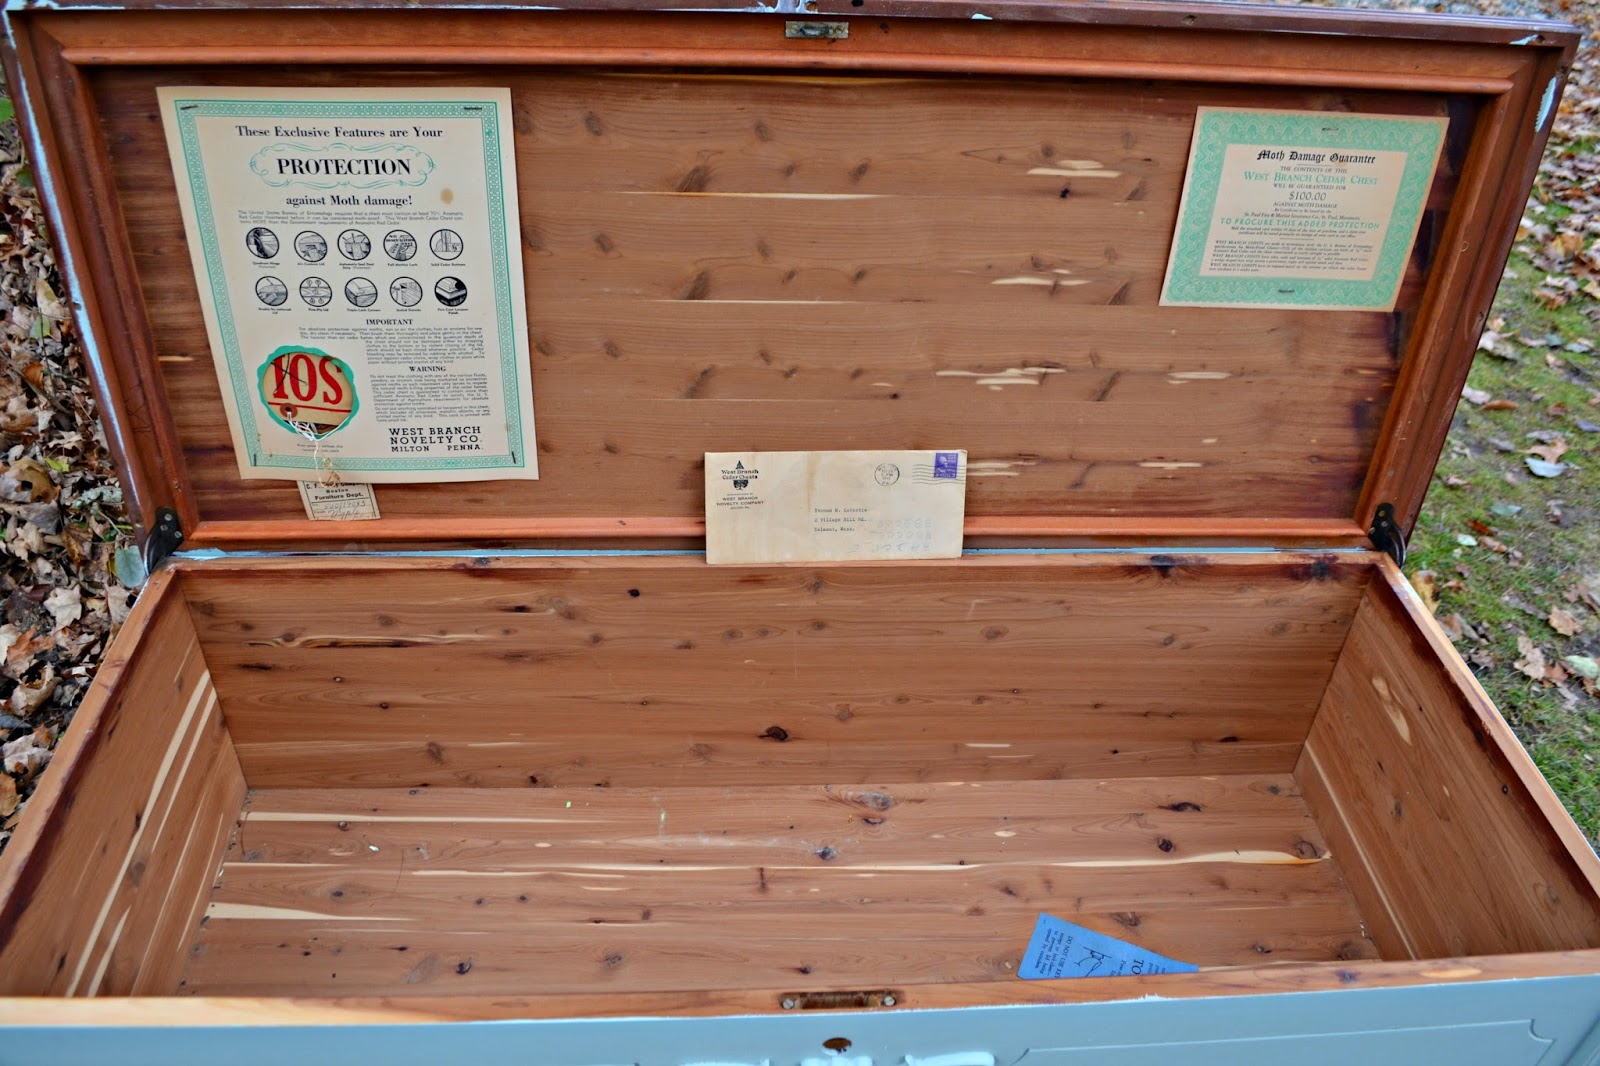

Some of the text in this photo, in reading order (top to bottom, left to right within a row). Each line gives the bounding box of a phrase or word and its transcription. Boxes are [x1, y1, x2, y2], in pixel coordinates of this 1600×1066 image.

[235, 126, 443, 138] These Exclusive Features are Your
[1257, 149, 1376, 164] Moth Damage Guarantee
[276, 158, 411, 175] PROTECTION
[286, 195, 412, 208] against Moth damage!
[1288, 190, 1327, 201] $100.00
[1220, 217, 1380, 229] TO PROCURE THIS ADDED PROTECTION
[389, 426, 481, 436] WEST BRANCH
[390, 435, 483, 445] NOVELTY CO.
[391, 445, 430, 453] MILTON
[1066, 935, 1074, 945] DO
[1062, 944, 1070, 957] NOT
[1058, 957, 1066, 968] USE
[1131, 958, 1145, 975] TO
